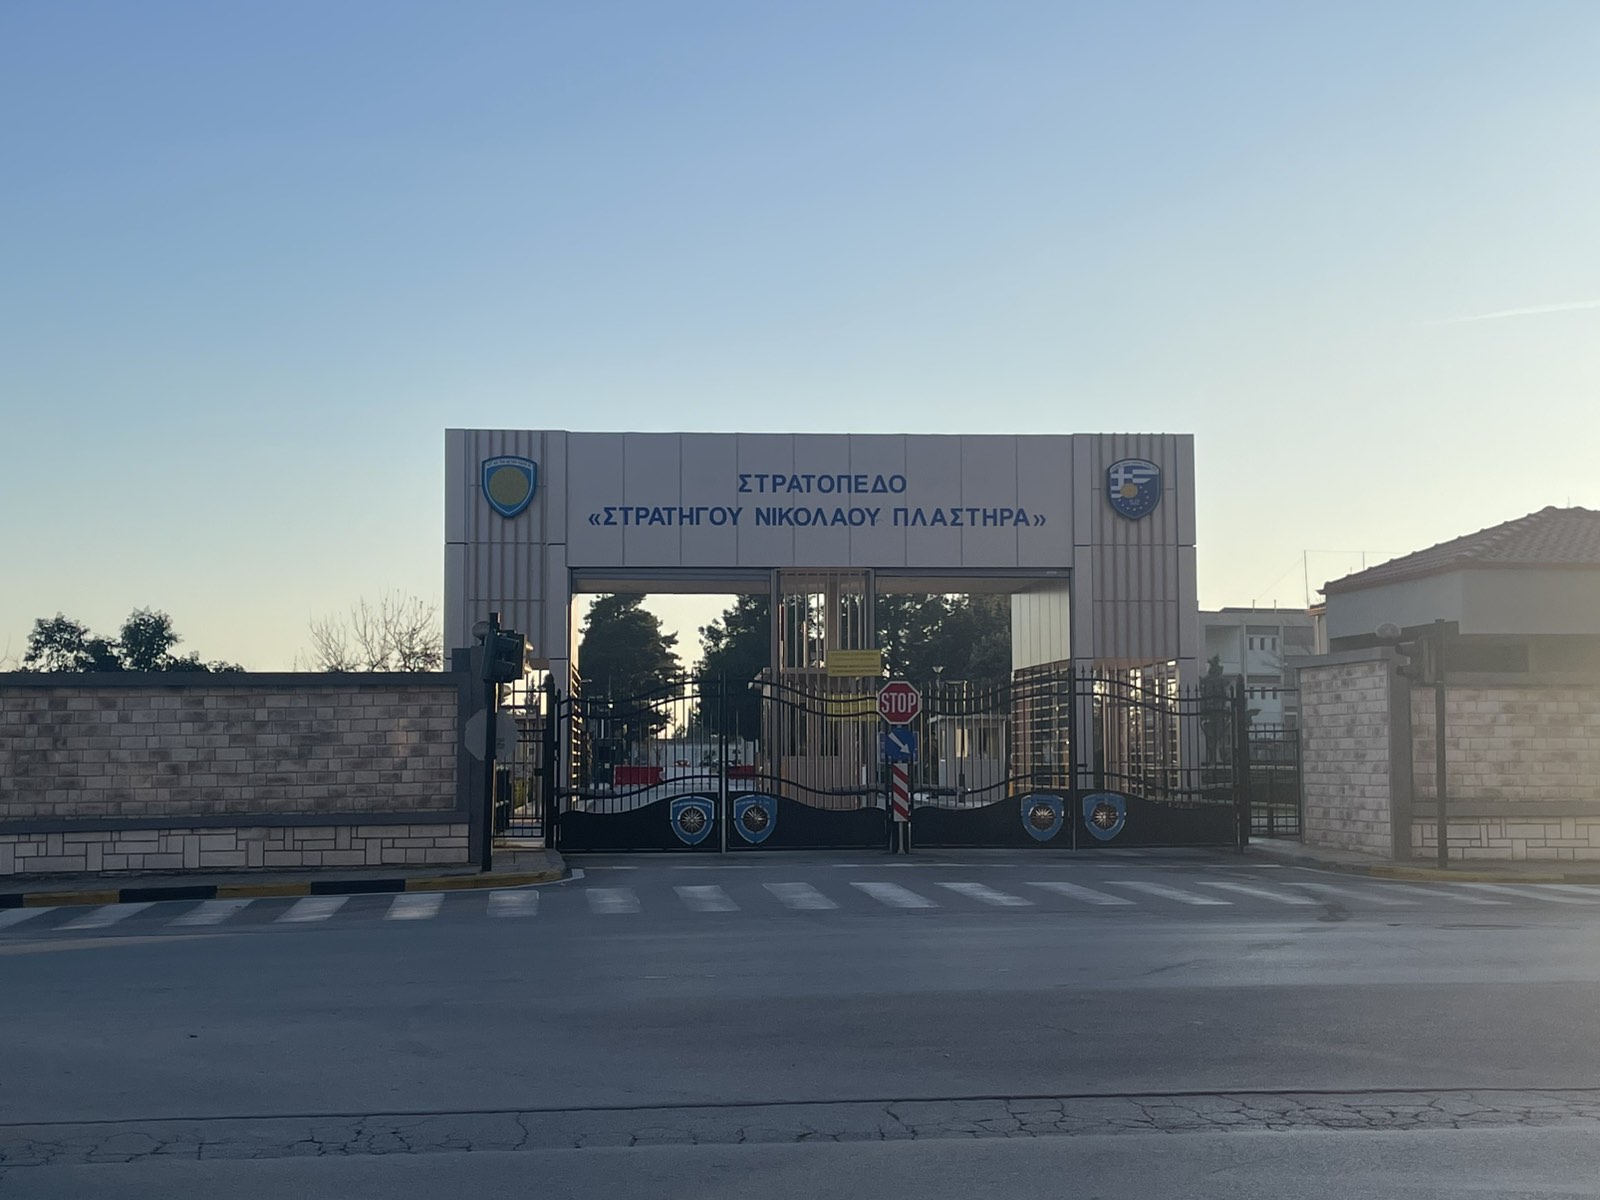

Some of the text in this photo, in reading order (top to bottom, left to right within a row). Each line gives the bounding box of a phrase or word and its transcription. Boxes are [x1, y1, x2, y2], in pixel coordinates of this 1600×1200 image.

[738, 474, 907, 493] ΣΤΡΑΤΟΠΕΔΟ
[588, 506, 1047, 527] «ΣΤΡΑΤΗΓΟΥ ΝΙΚΟΛΑΟΥ ΠΛΑΣΤΗΡΑ»
[881, 692, 917, 714] STOP
